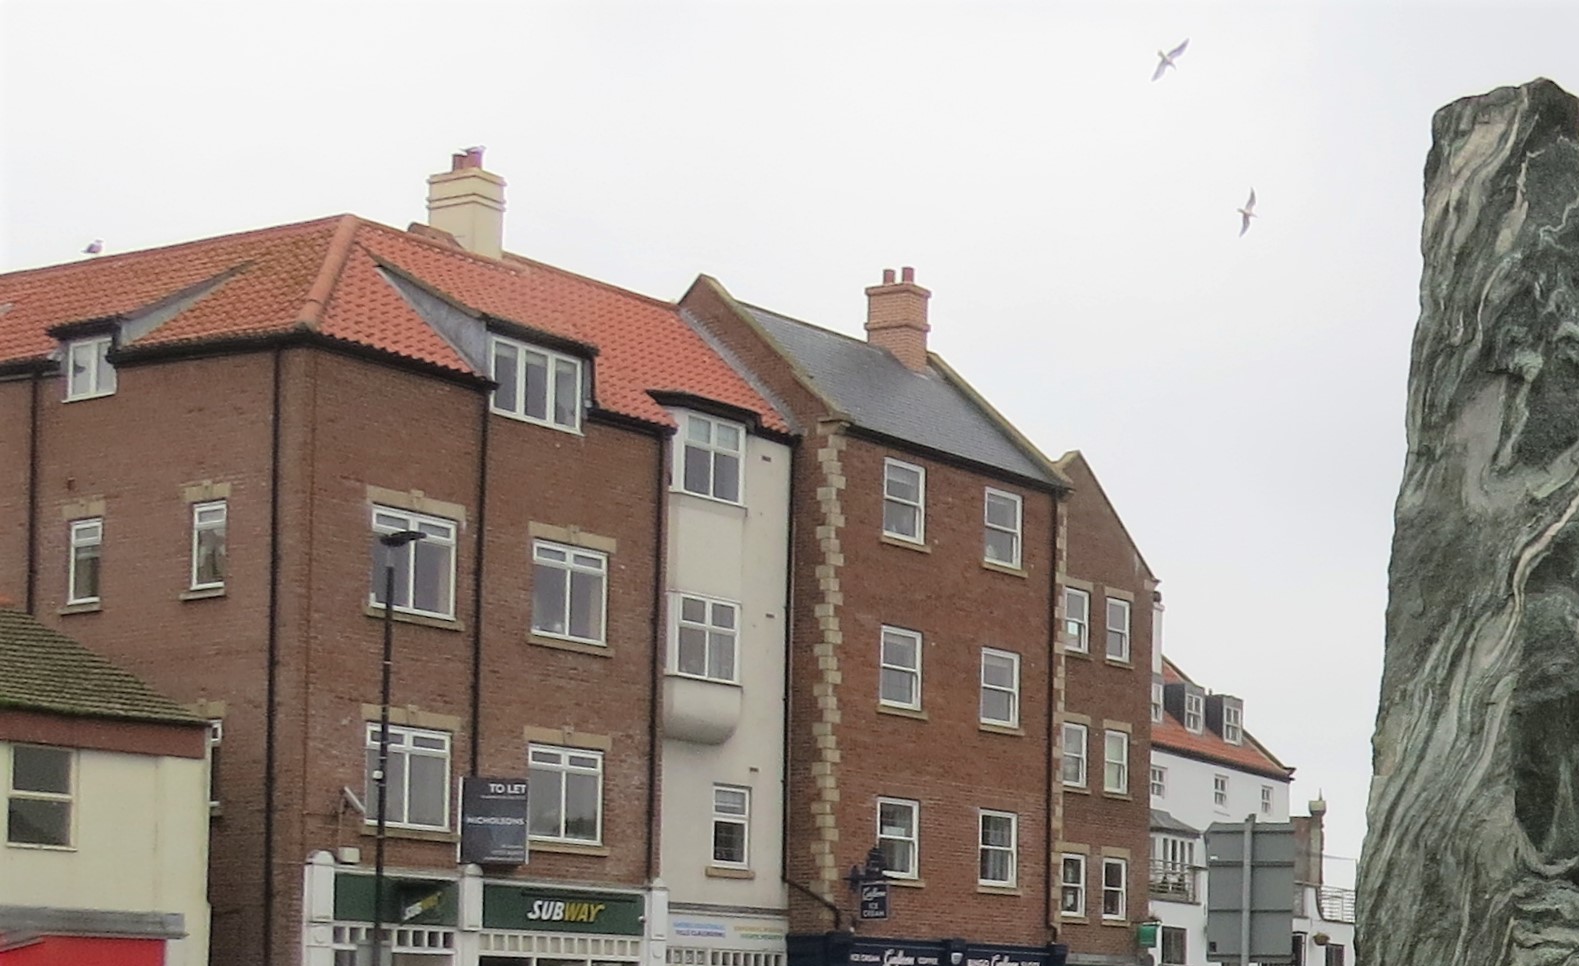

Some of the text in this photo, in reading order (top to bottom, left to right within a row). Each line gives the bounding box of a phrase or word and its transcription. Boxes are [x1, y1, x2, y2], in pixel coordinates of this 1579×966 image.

[489, 783, 527, 794] TO LET
[527, 899, 605, 922] SUBWAY
